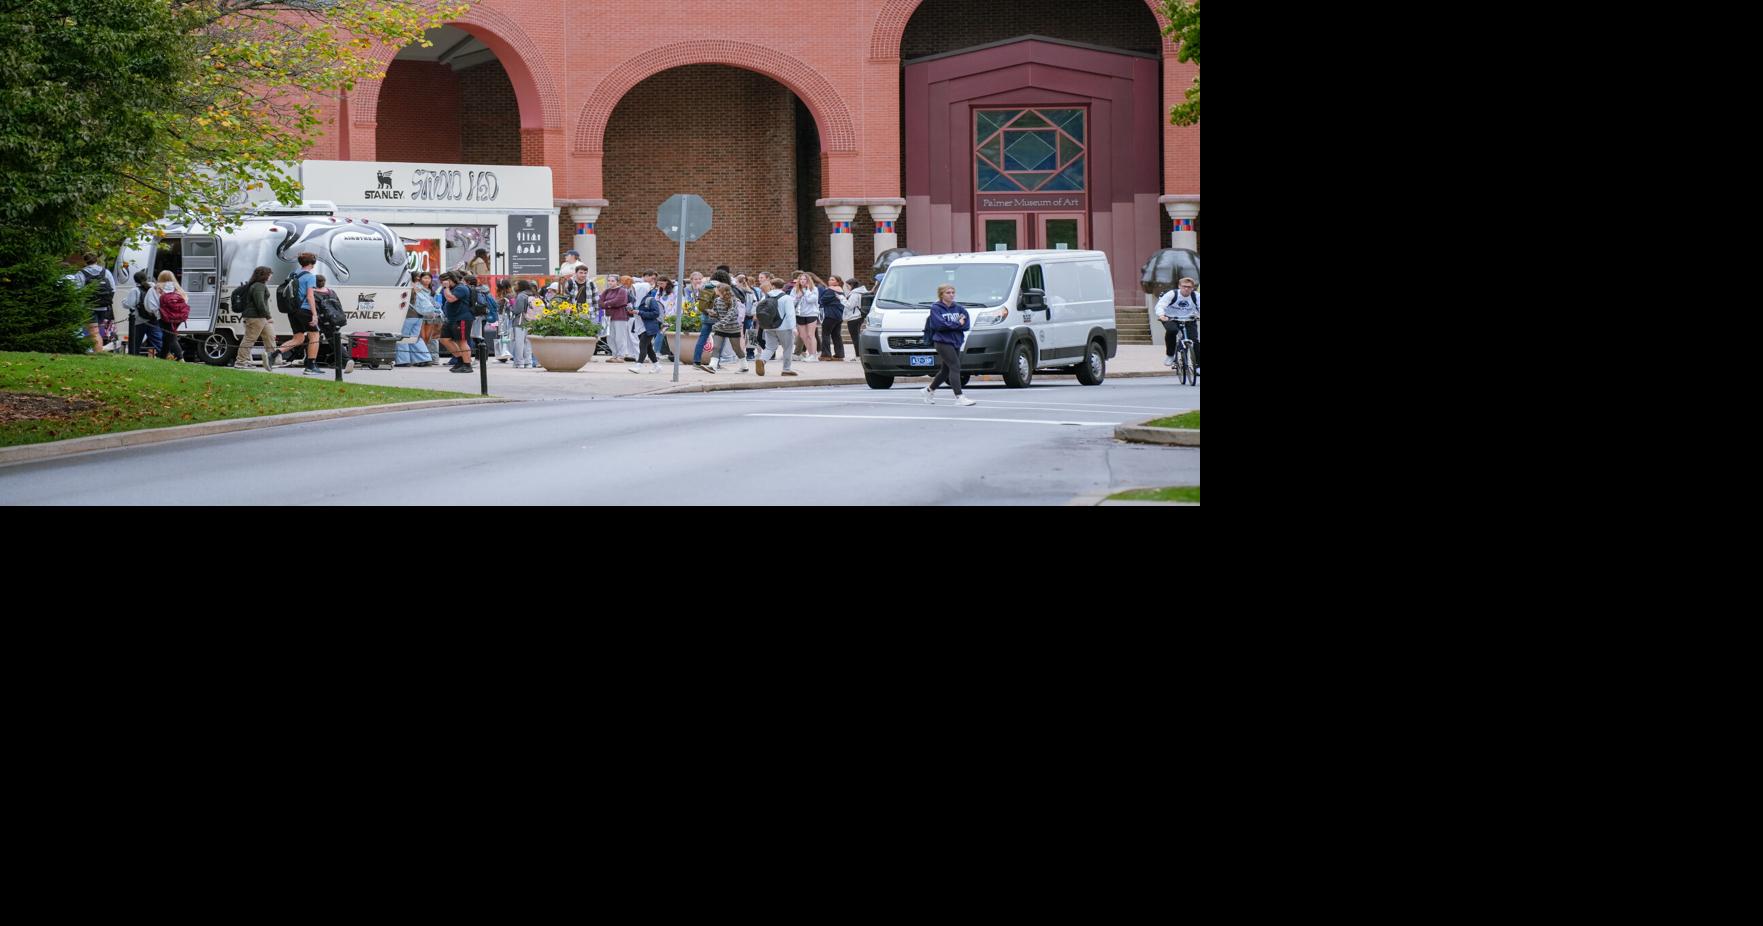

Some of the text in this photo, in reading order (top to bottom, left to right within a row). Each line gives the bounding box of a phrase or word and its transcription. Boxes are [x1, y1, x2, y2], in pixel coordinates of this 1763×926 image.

[365, 190, 404, 199] STANLEY
[983, 198, 1079, 207] Palmer Museum of Art
[217, 315, 244, 324] NLEY
[345, 311, 385, 319] TANLEY
